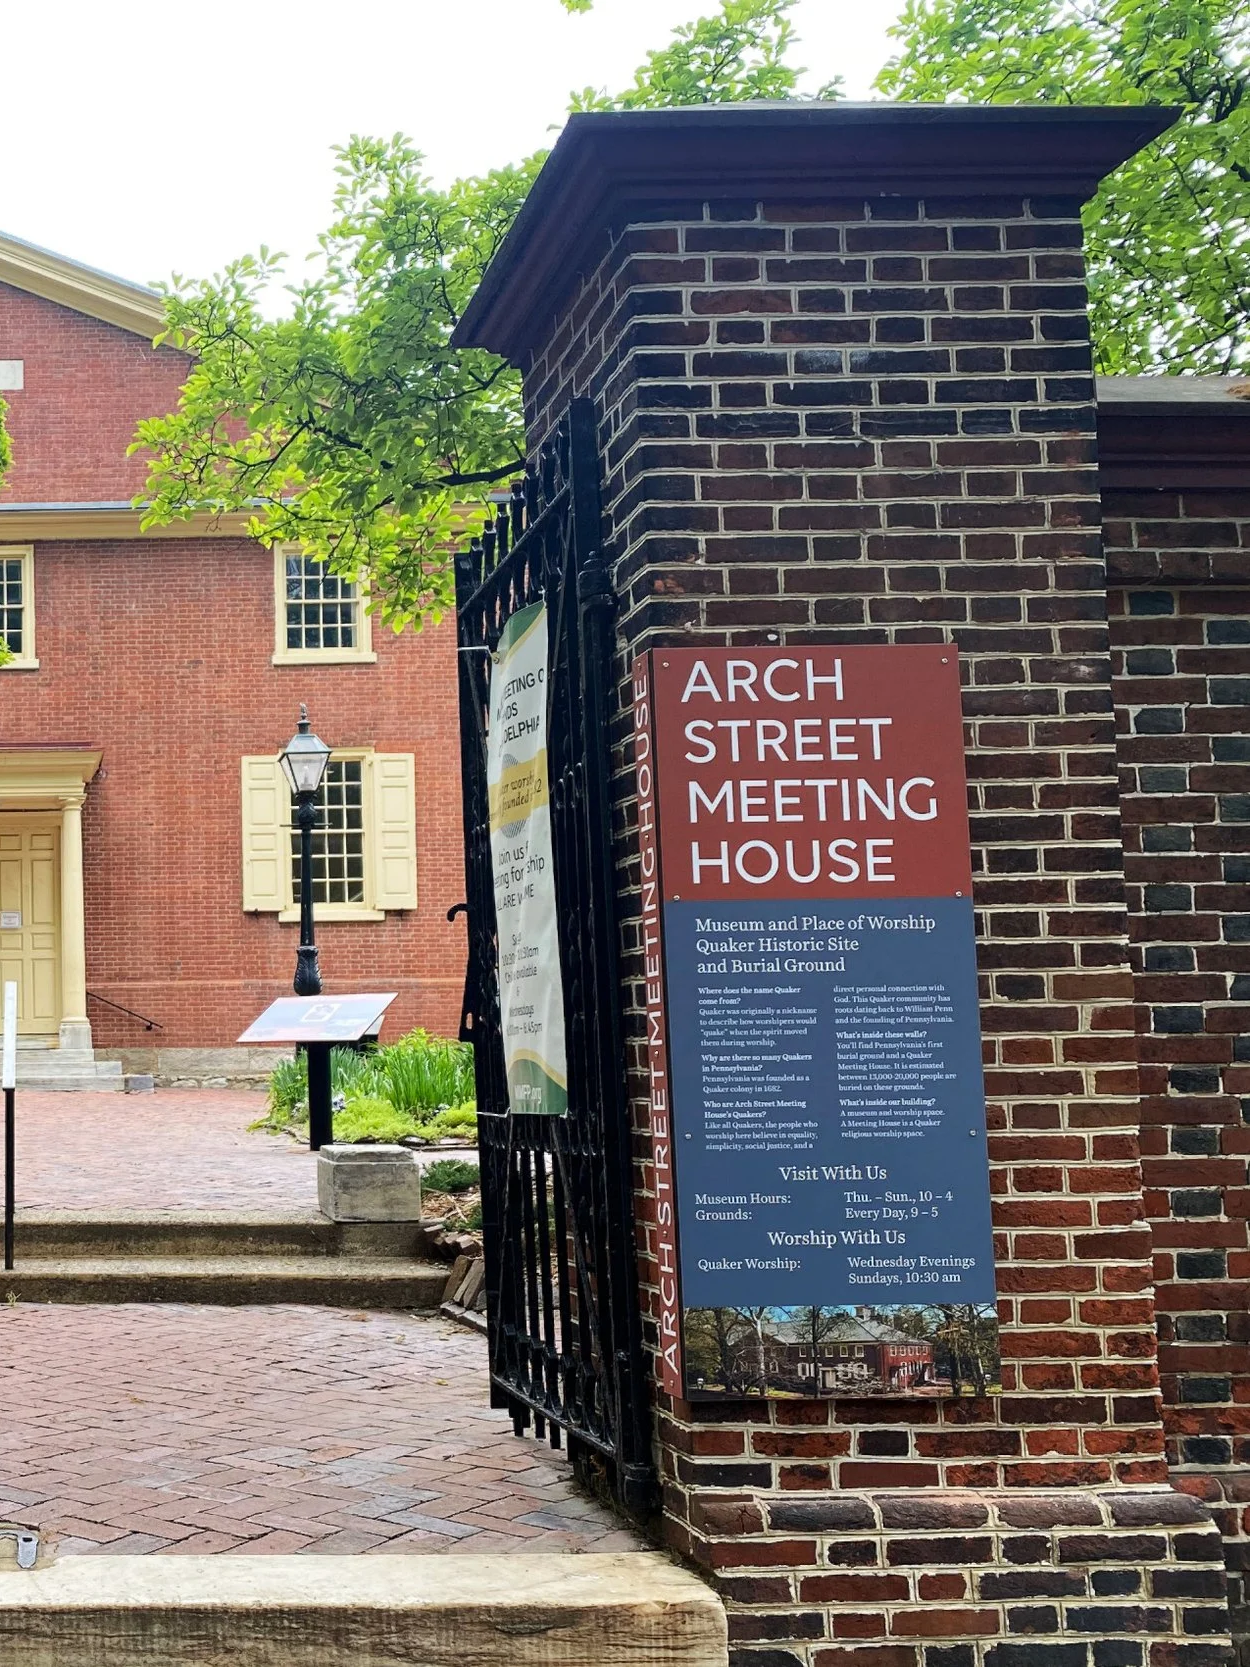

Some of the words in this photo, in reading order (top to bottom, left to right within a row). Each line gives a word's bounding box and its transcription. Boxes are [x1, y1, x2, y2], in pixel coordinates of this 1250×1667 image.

[681, 658, 844, 703] ARCH
[684, 717, 893, 764] STREET
[633, 674, 652, 832] HOUSE
[688, 776, 938, 823] MEETING
[691, 838, 896, 884] HOUSE
[695, 918, 765, 932] Museum
[768, 916, 798, 931] and
[801, 916, 845, 931] Place
[848, 915, 865, 930] of
[866, 914, 936, 933] Worship
[641, 847, 663, 1045] MEETING
[696, 937, 756, 955] Quaker
[758, 937, 825, 952] Historic
[828, 936, 859, 951] Site
[697, 958, 728, 974] and
[731, 957, 781, 973] Burial
[784, 957, 846, 972] Ground
[703, 1100, 722, 1108] Who
[734, 1100, 753, 1108] Arch
[753, 1100, 776, 1108] Street
[776, 1100, 807, 1109] Meeting
[732, 1110, 767, 1120] Quakers?
[651, 1061, 671, 1226] STREET
[778, 1166, 819, 1181] Visit
[820, 1165, 863, 1180] With
[865, 1166, 887, 1180] Us
[695, 1194, 748, 1205] Museum
[750, 1193, 791, 1204] Hours:
[844, 1191, 872, 1203] Thu.
[885, 1191, 916, 1204] Sun.,
[919, 1190, 933, 1202] 10
[945, 1191, 954, 1201] 4
[695, 1208, 752, 1221] Grounds:
[845, 1208, 880, 1221] Every
[882, 1207, 908, 1221] Day,
[910, 1207, 918, 1218] 9
[931, 1206, 938, 1218] 5
[767, 1230, 837, 1249] Worship
[839, 1229, 882, 1245] With
[884, 1230, 906, 1244] Us
[698, 1258, 743, 1272] Quaker
[744, 1257, 801, 1272] Worship:
[847, 1255, 917, 1270] Wednesday
[919, 1255, 976, 1270] Evenings
[848, 1271, 903, 1286] Sundays,
[906, 1272, 940, 1283] 10:30
[942, 1274, 961, 1283] am
[660, 1242, 678, 1375] ARCH
